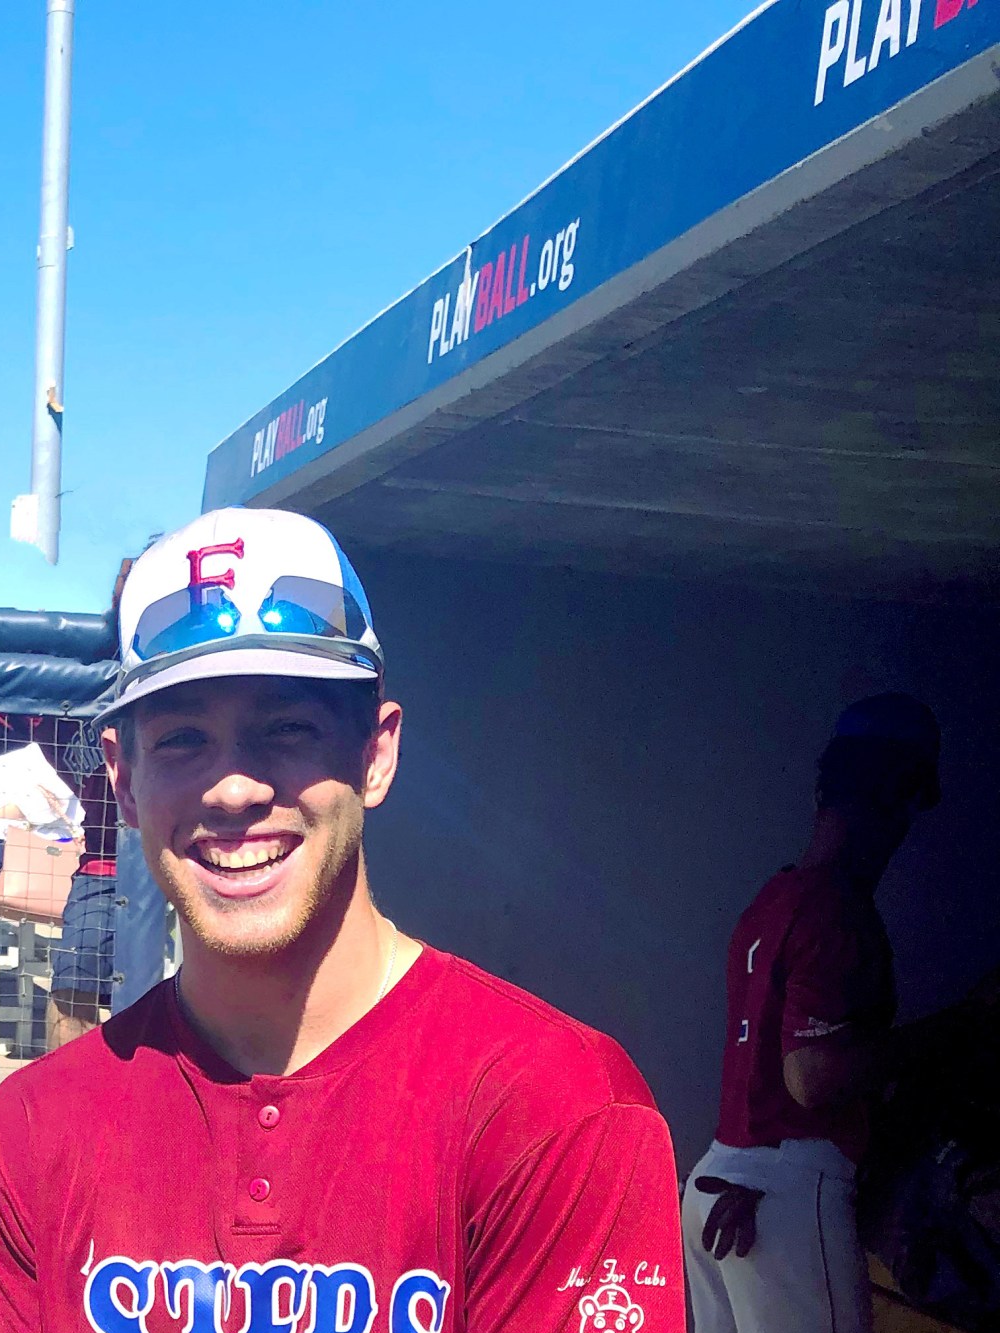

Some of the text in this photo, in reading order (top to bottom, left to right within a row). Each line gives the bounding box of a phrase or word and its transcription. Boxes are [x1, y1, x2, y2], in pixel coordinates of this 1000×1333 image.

[428, 217, 580, 364] PLAYBALL.org
[250, 397, 328, 478] PLAYBALL.org
[186, 537, 245, 614] F
[634, 1261, 666, 1286] Cubs
